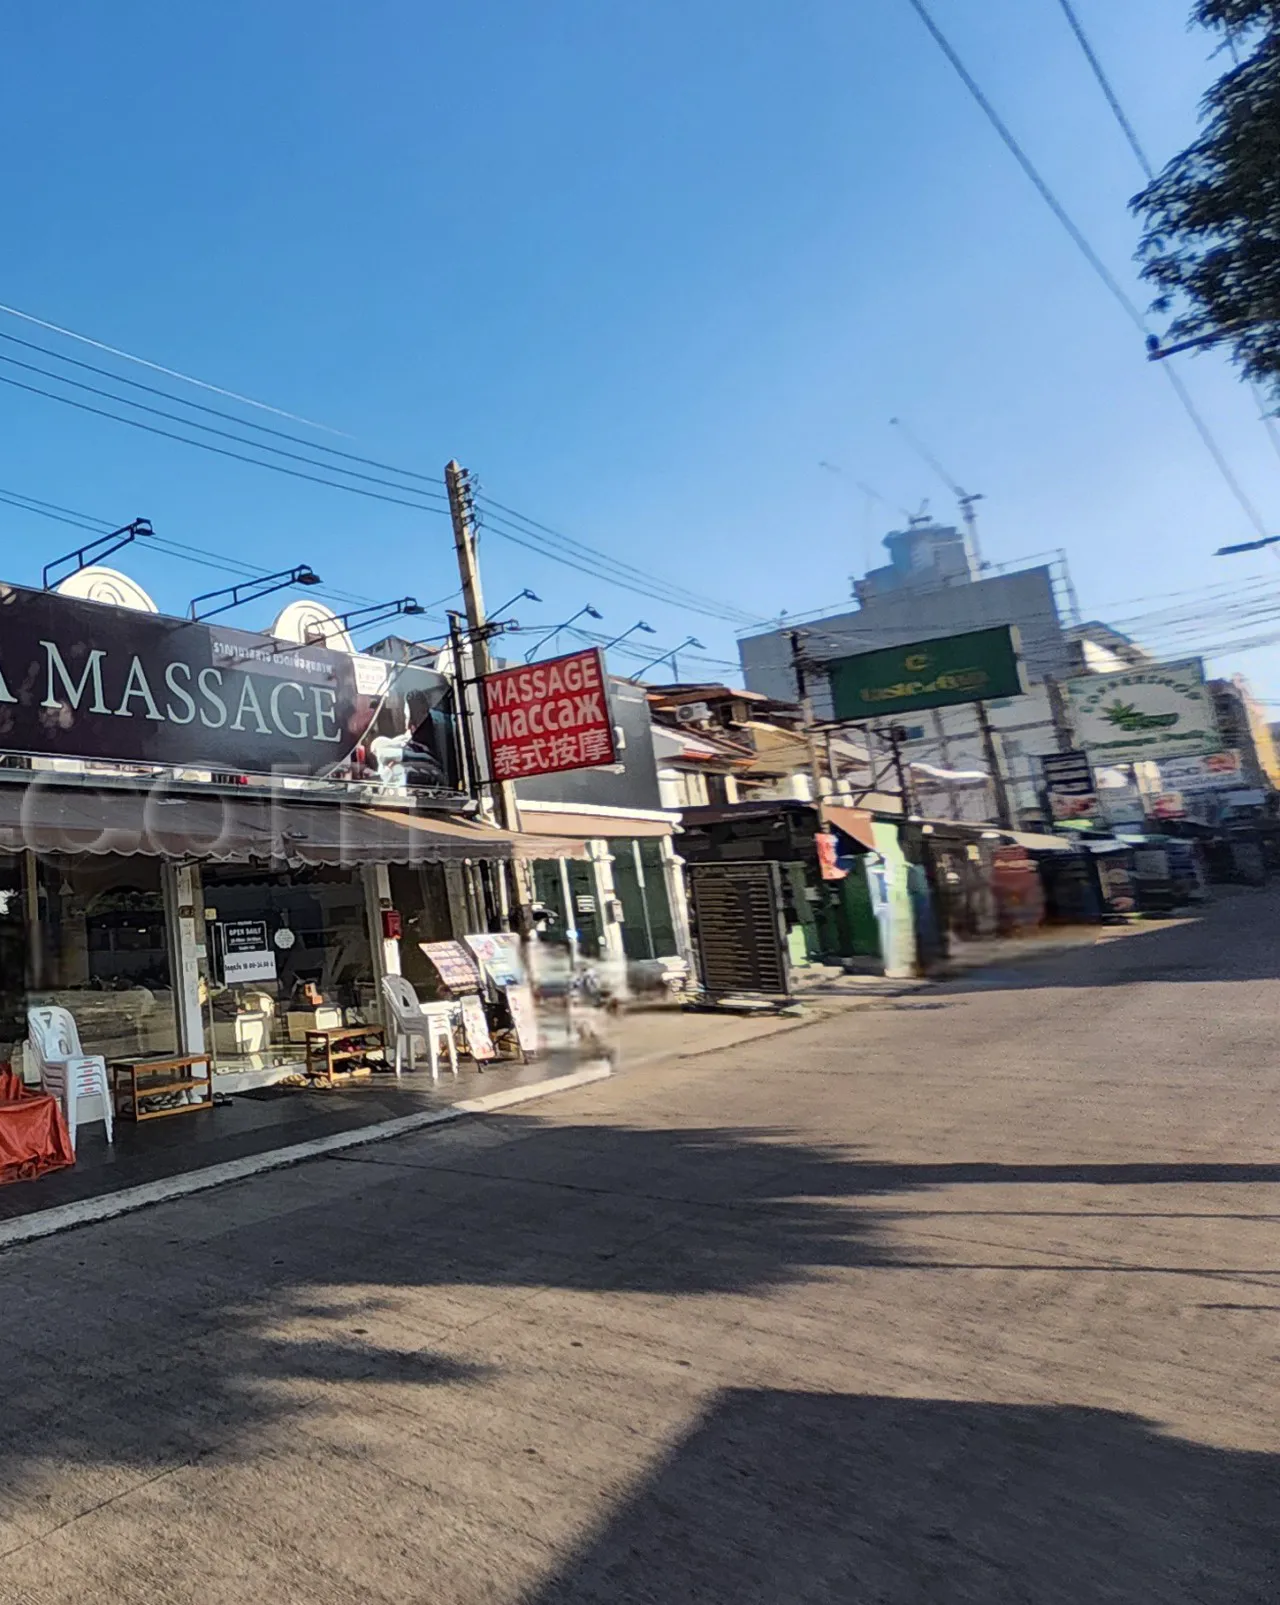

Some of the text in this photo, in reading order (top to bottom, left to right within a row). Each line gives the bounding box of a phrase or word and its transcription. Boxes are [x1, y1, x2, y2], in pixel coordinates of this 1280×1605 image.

[39, 640, 342, 744] MASSAGE
[486, 657, 599, 709] MASSAGE
[490, 692, 605, 742] массаж
[493, 728, 610, 776] 泰式按摩
